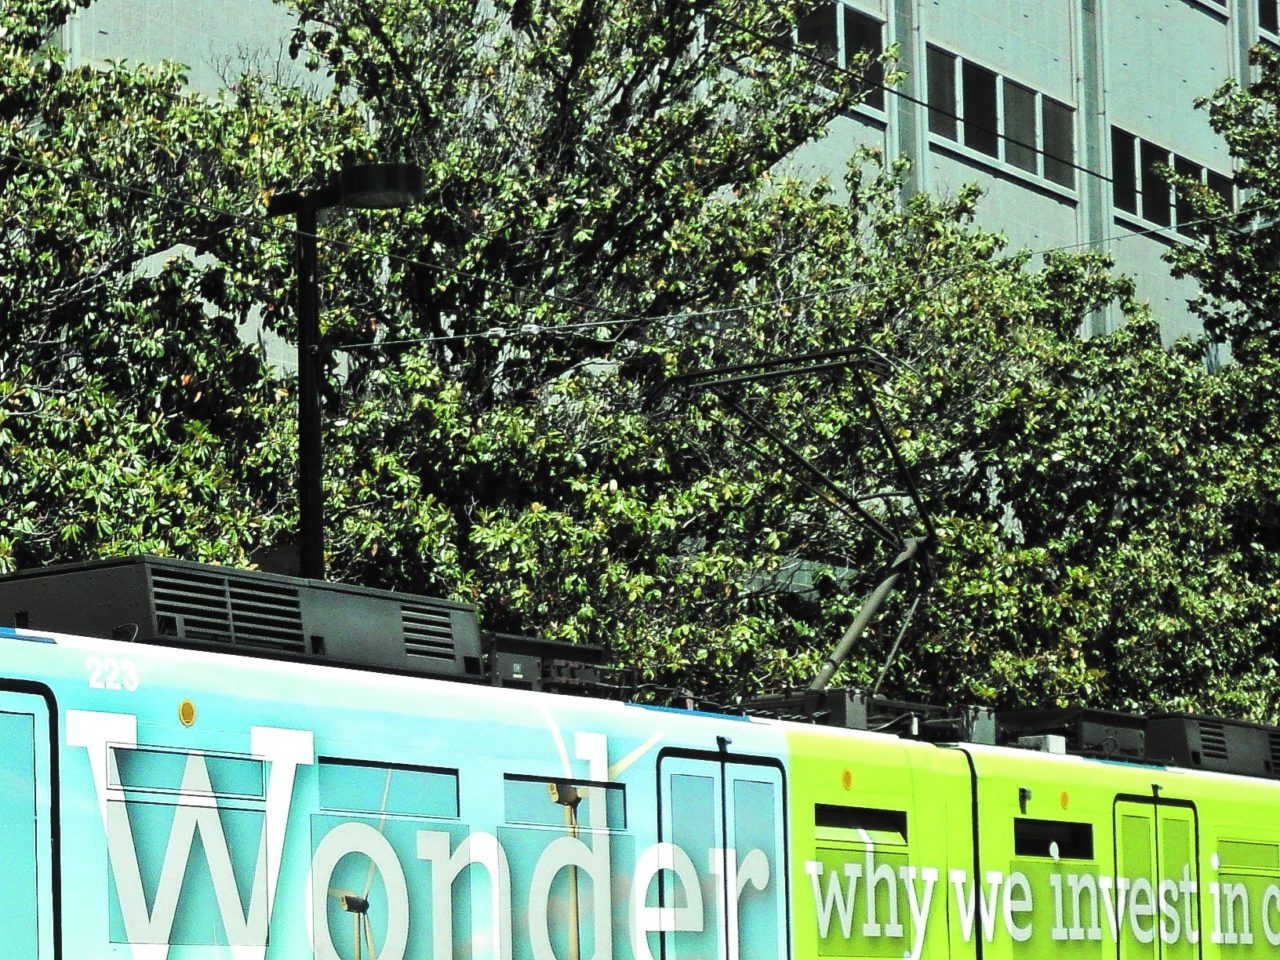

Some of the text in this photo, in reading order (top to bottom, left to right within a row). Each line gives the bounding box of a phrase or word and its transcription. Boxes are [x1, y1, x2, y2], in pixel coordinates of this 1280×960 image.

[85, 655, 141, 693] 223
[949, 868, 1034, 943] we
[1049, 841, 1200, 945] invest
[1209, 852, 1254, 945] in
